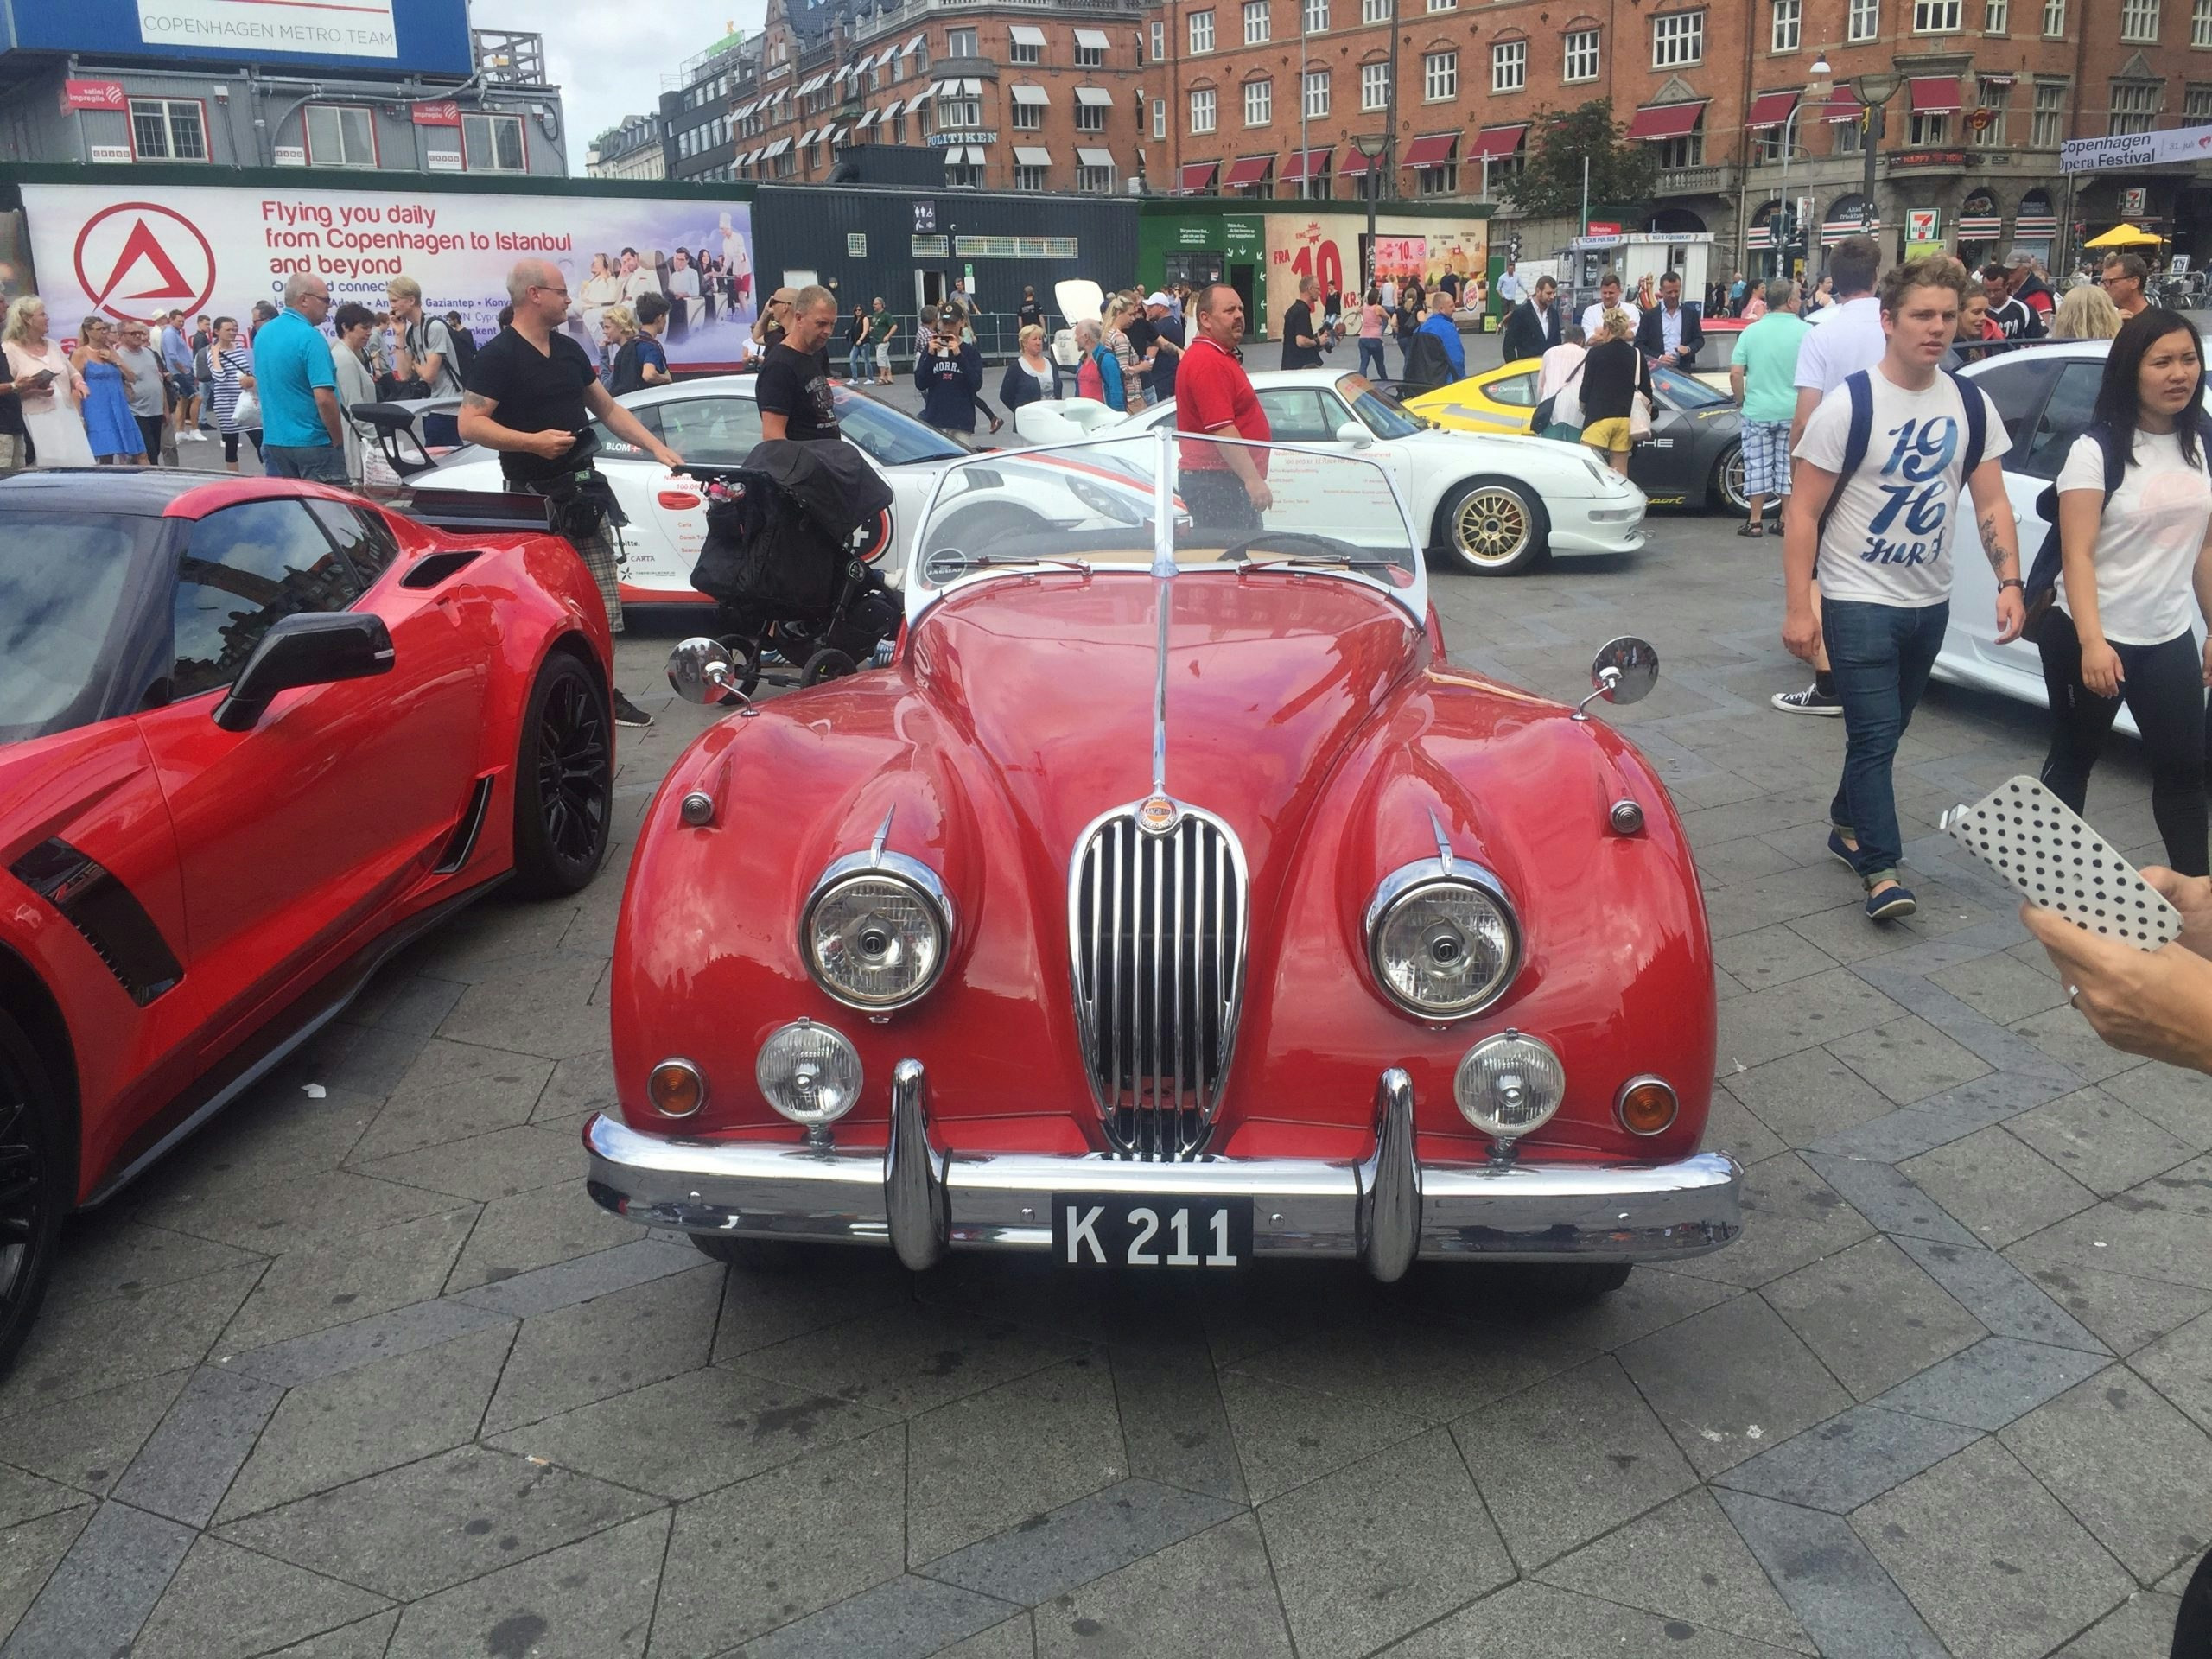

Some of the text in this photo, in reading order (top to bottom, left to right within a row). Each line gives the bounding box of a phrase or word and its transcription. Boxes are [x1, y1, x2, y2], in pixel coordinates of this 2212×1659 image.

[143, 16, 394, 46] COPENHAGEN METRO TEAM
[926, 132, 997, 148] POLITIKEN
[2061, 135, 2151, 156] Copenhagen
[2098, 148, 2155, 167] Festival
[261, 200, 435, 229] Flying you daily
[265, 228, 572, 255] from Copenhagen to Istanbul
[1399, 240, 1410, 261] 10
[270, 255, 402, 279] and beyond
[1274, 249, 1290, 264] FRA
[338, 280, 389, 292] connec
[425, 298, 474, 309] Gaziantep
[1343, 291, 1359, 309] KR.
[606, 442, 631, 453] BLOM
[1880, 416, 1958, 483] 19
[1868, 480, 1948, 536] 76
[1065, 1205, 1237, 1266] K 211
